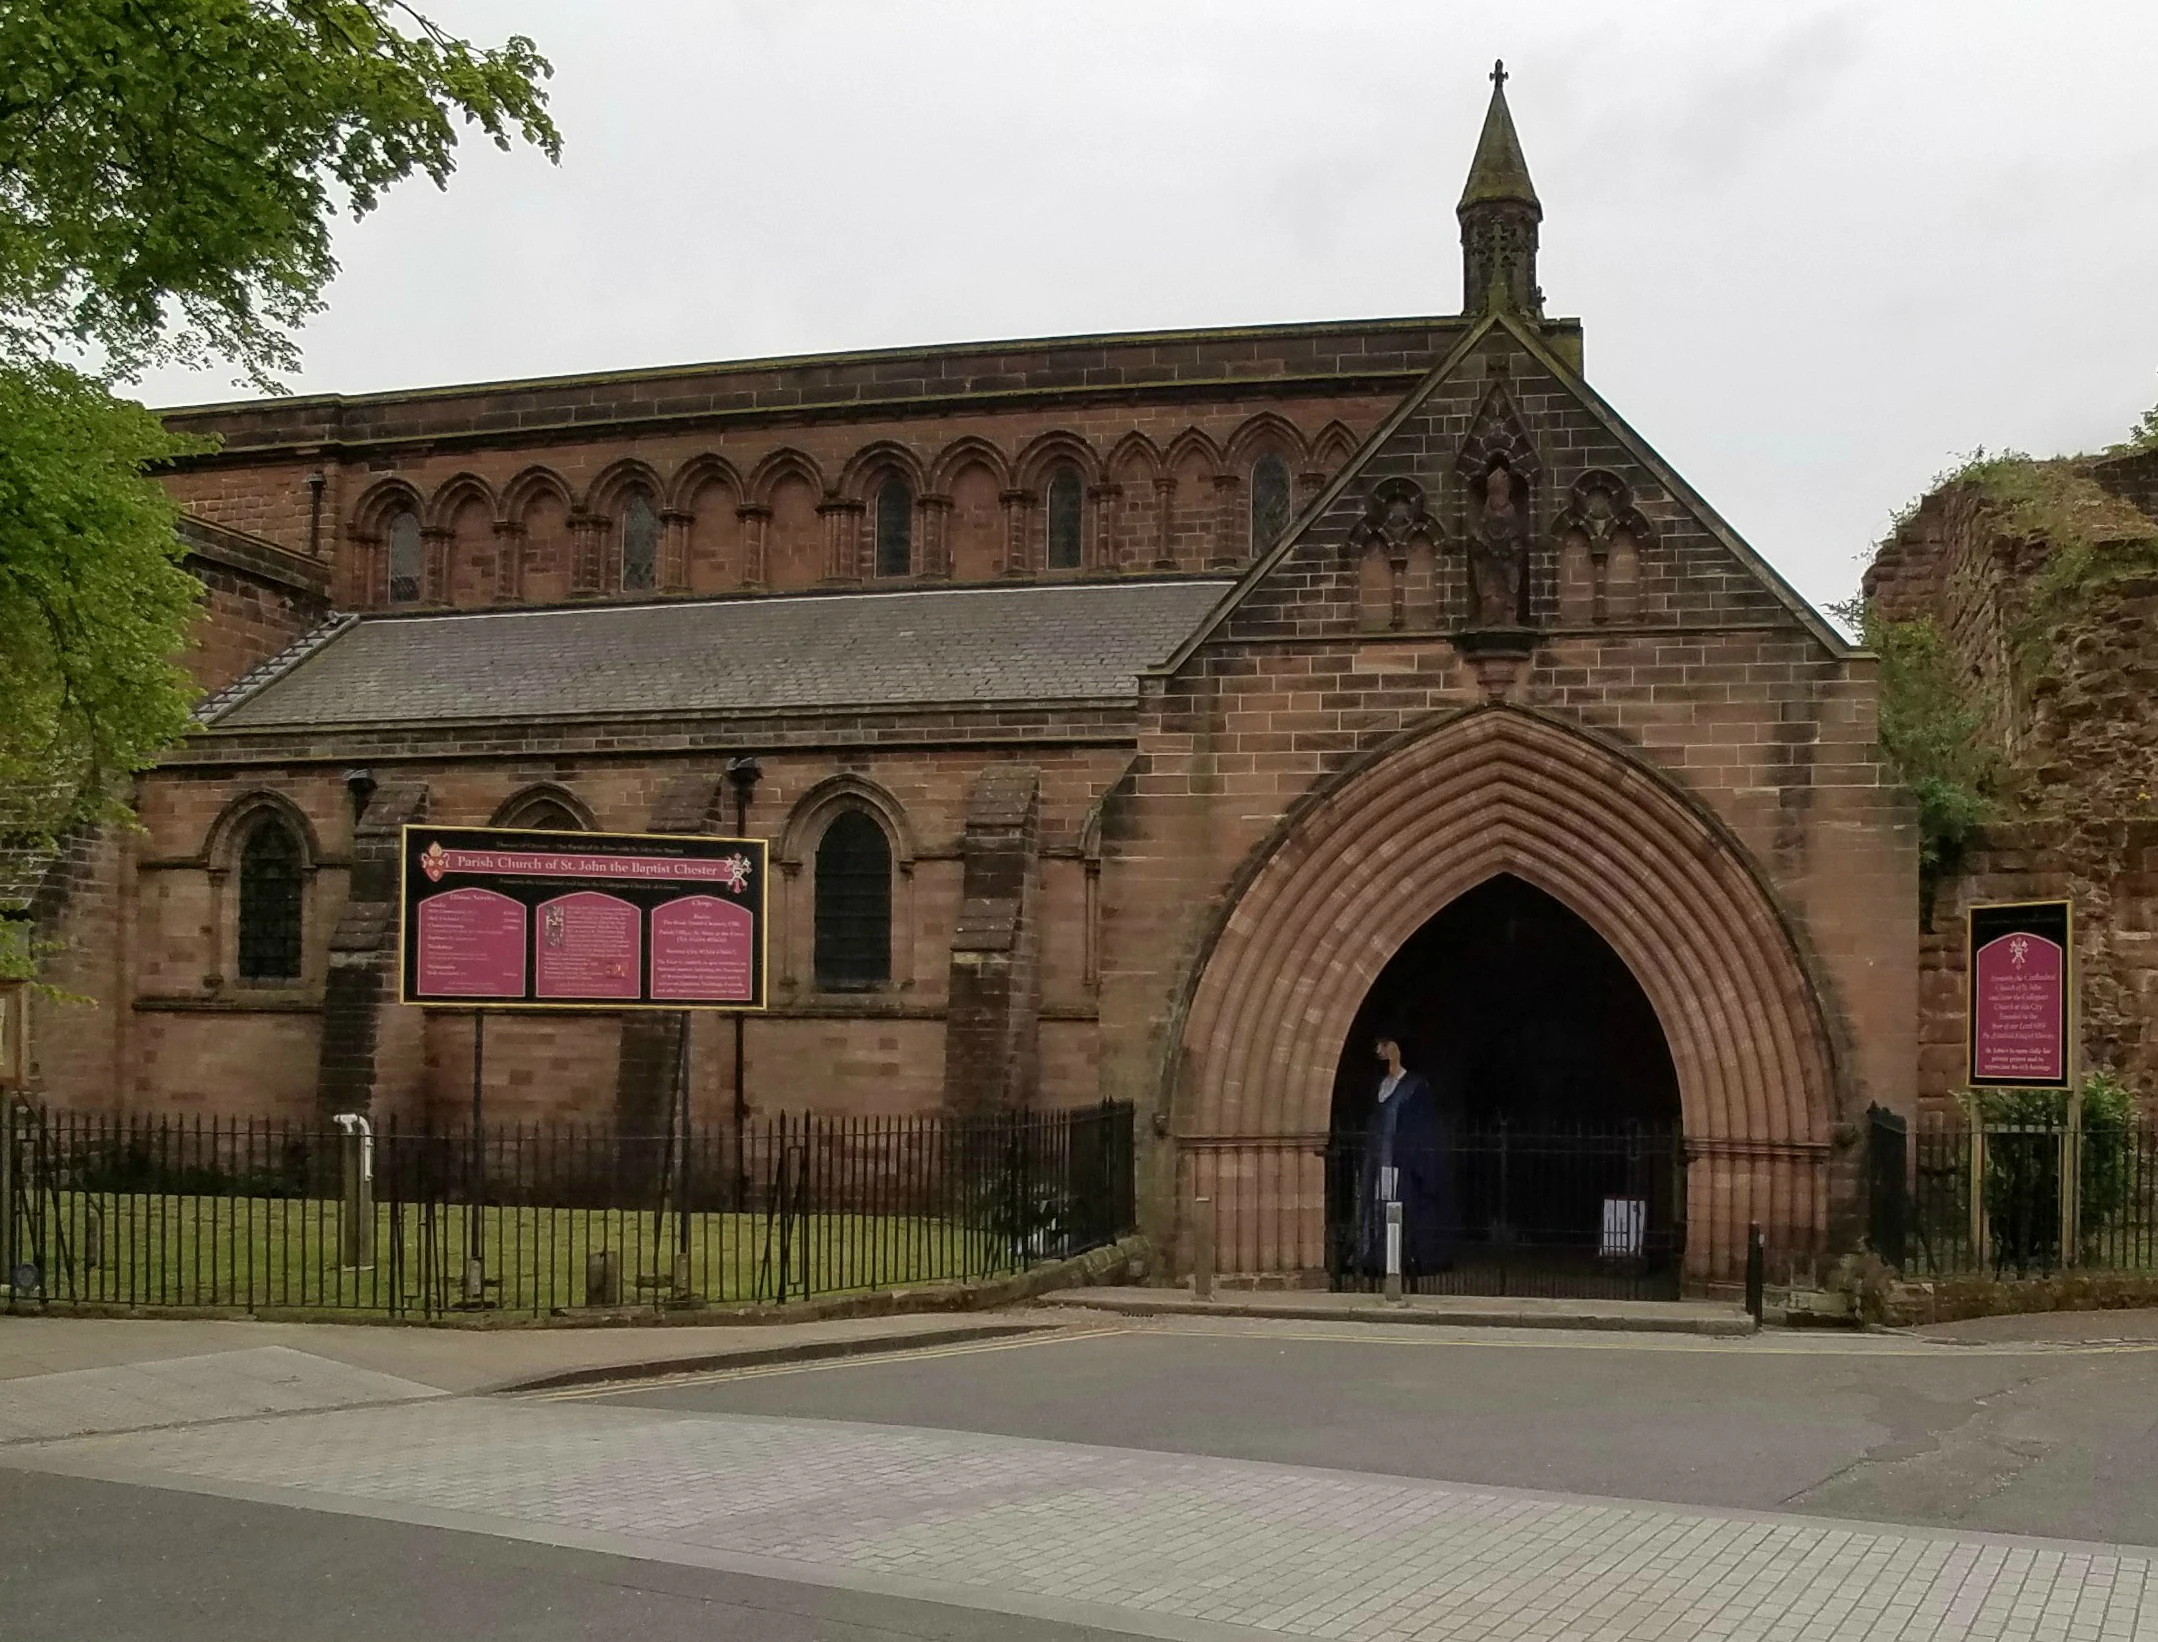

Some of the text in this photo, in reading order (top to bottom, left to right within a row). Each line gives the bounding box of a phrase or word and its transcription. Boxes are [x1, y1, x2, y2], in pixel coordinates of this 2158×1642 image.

[458, 856, 493, 868] Parish
[497, 857, 542, 870] Church
[545, 858, 558, 870] of
[579, 860, 606, 872] John
[610, 860, 629, 872] the
[632, 861, 670, 875] Baptist
[674, 863, 717, 876] Chester
